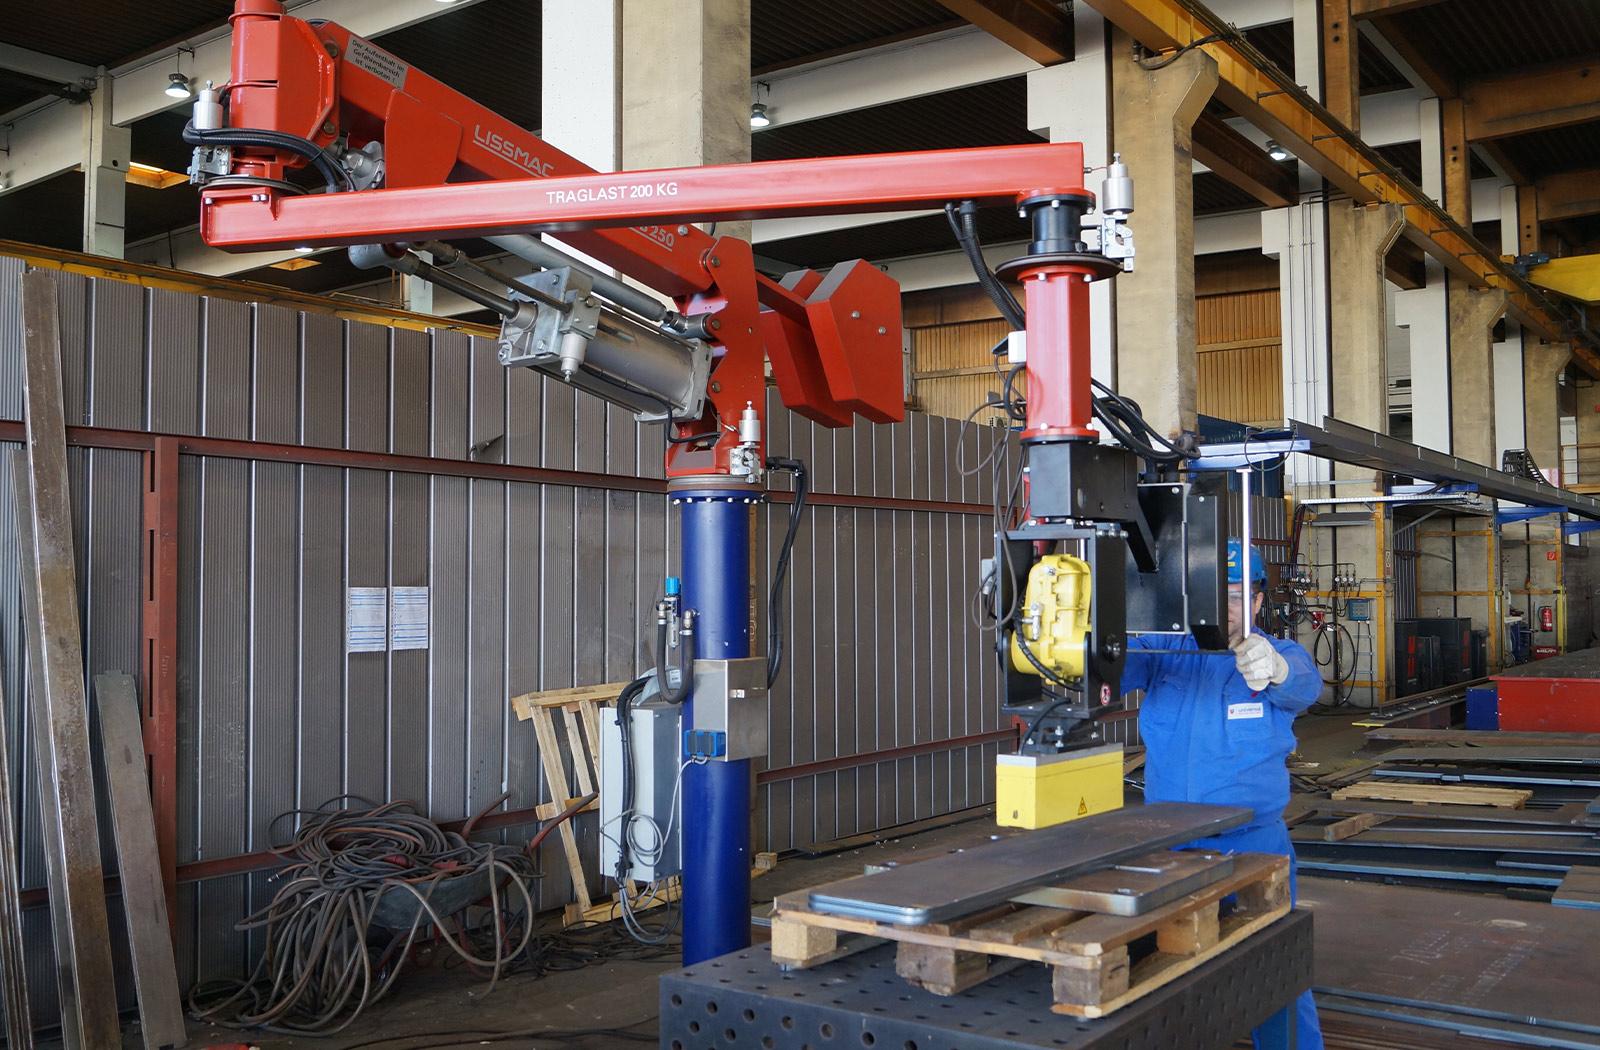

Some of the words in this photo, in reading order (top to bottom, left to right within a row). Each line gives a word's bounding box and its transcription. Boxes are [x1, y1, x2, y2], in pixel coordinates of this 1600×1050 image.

[352, 39, 363, 49] Der
[364, 46, 396, 67] Aufenthalt
[353, 48, 400, 78] Gefahrenbereich
[365, 63, 391, 81] verboten
[474, 124, 554, 178] LISSMAC
[546, 186, 627, 204] TRAGLAST
[630, 184, 653, 199] 200
[656, 182, 678, 196] KG
[650, 225, 674, 247] 250
